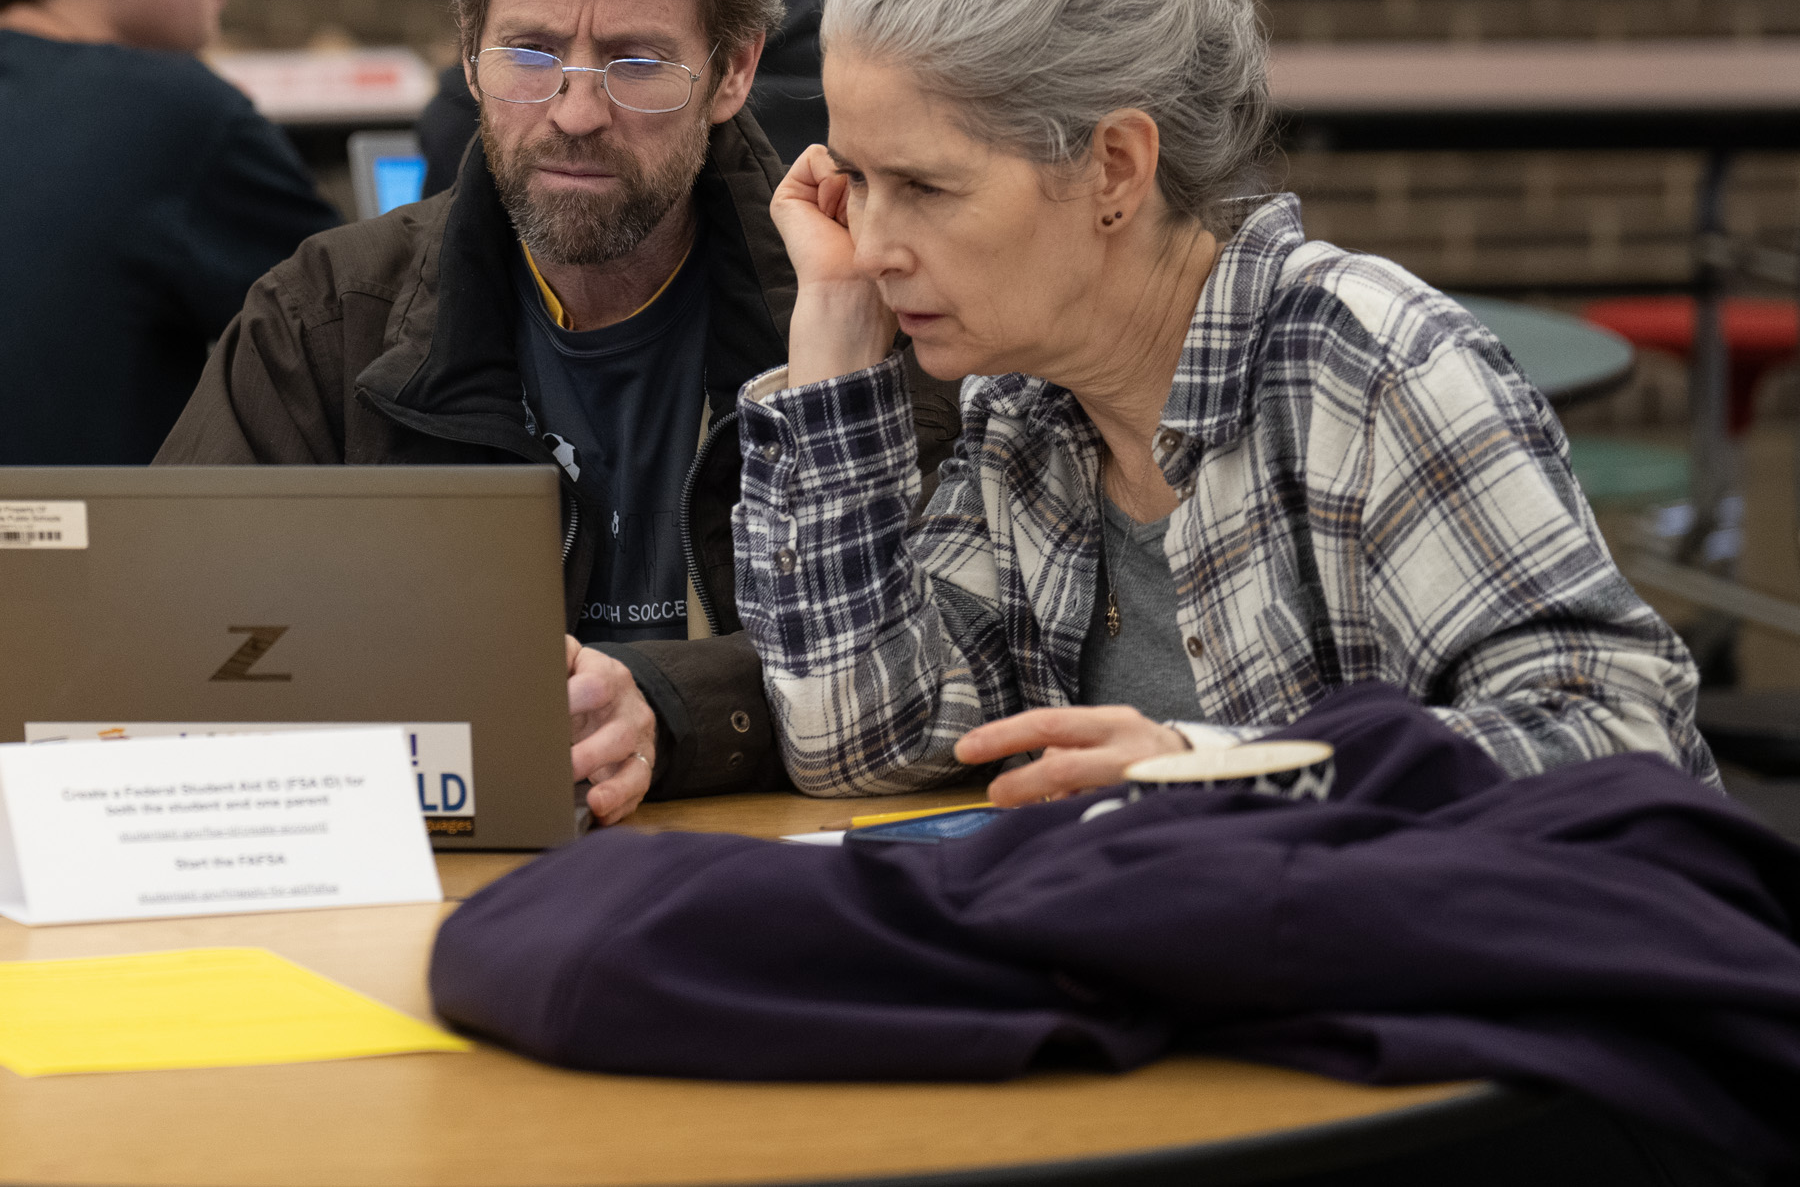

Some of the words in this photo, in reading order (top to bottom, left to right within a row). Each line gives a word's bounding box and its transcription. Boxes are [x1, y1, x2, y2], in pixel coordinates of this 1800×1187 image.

[628, 600, 688, 621] SOCCE
[208, 625, 292, 682] Z
[62, 788, 107, 800] Create
[125, 784, 176, 797] Federal
[182, 782, 234, 794] Student
[240, 780, 262, 791] Aid
[267, 778, 280, 791] ID
[287, 776, 316, 791] (FSA
[345, 775, 364, 787] for
[417, 773, 466, 812] LD
[105, 803, 136, 815] both
[142, 802, 164, 813] the
[169, 800, 220, 812] student
[226, 797, 251, 809] and
[256, 798, 281, 808] one
[286, 795, 329, 810] parent
[426, 819, 472, 834] guages
[174, 856, 209, 869] Start
[212, 856, 235, 867] the
[238, 854, 286, 866] FAFSA
